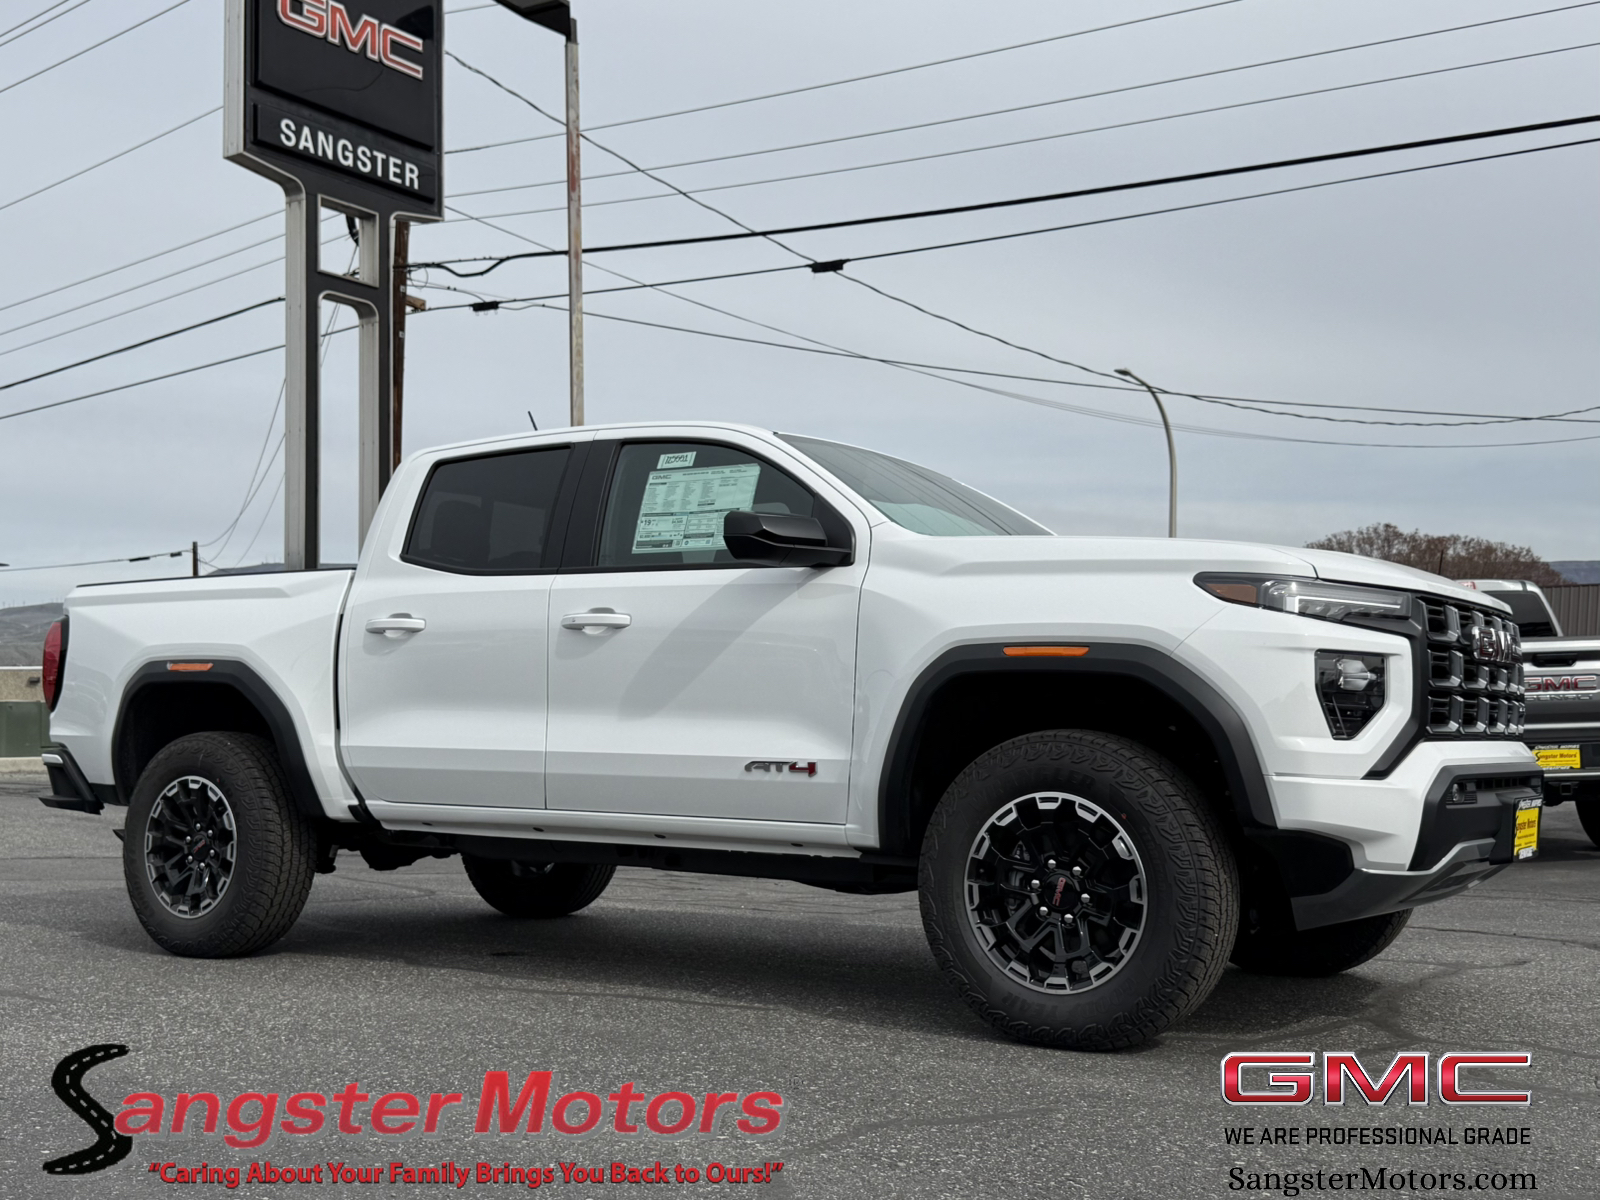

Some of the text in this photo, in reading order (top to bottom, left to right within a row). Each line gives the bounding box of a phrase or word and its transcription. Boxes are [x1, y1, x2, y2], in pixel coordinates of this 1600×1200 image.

[277, 0, 423, 80] GMC
[280, 118, 419, 190] SANGSTER
[1524, 675, 1597, 692] GMC
[744, 760, 818, 778] AT4
